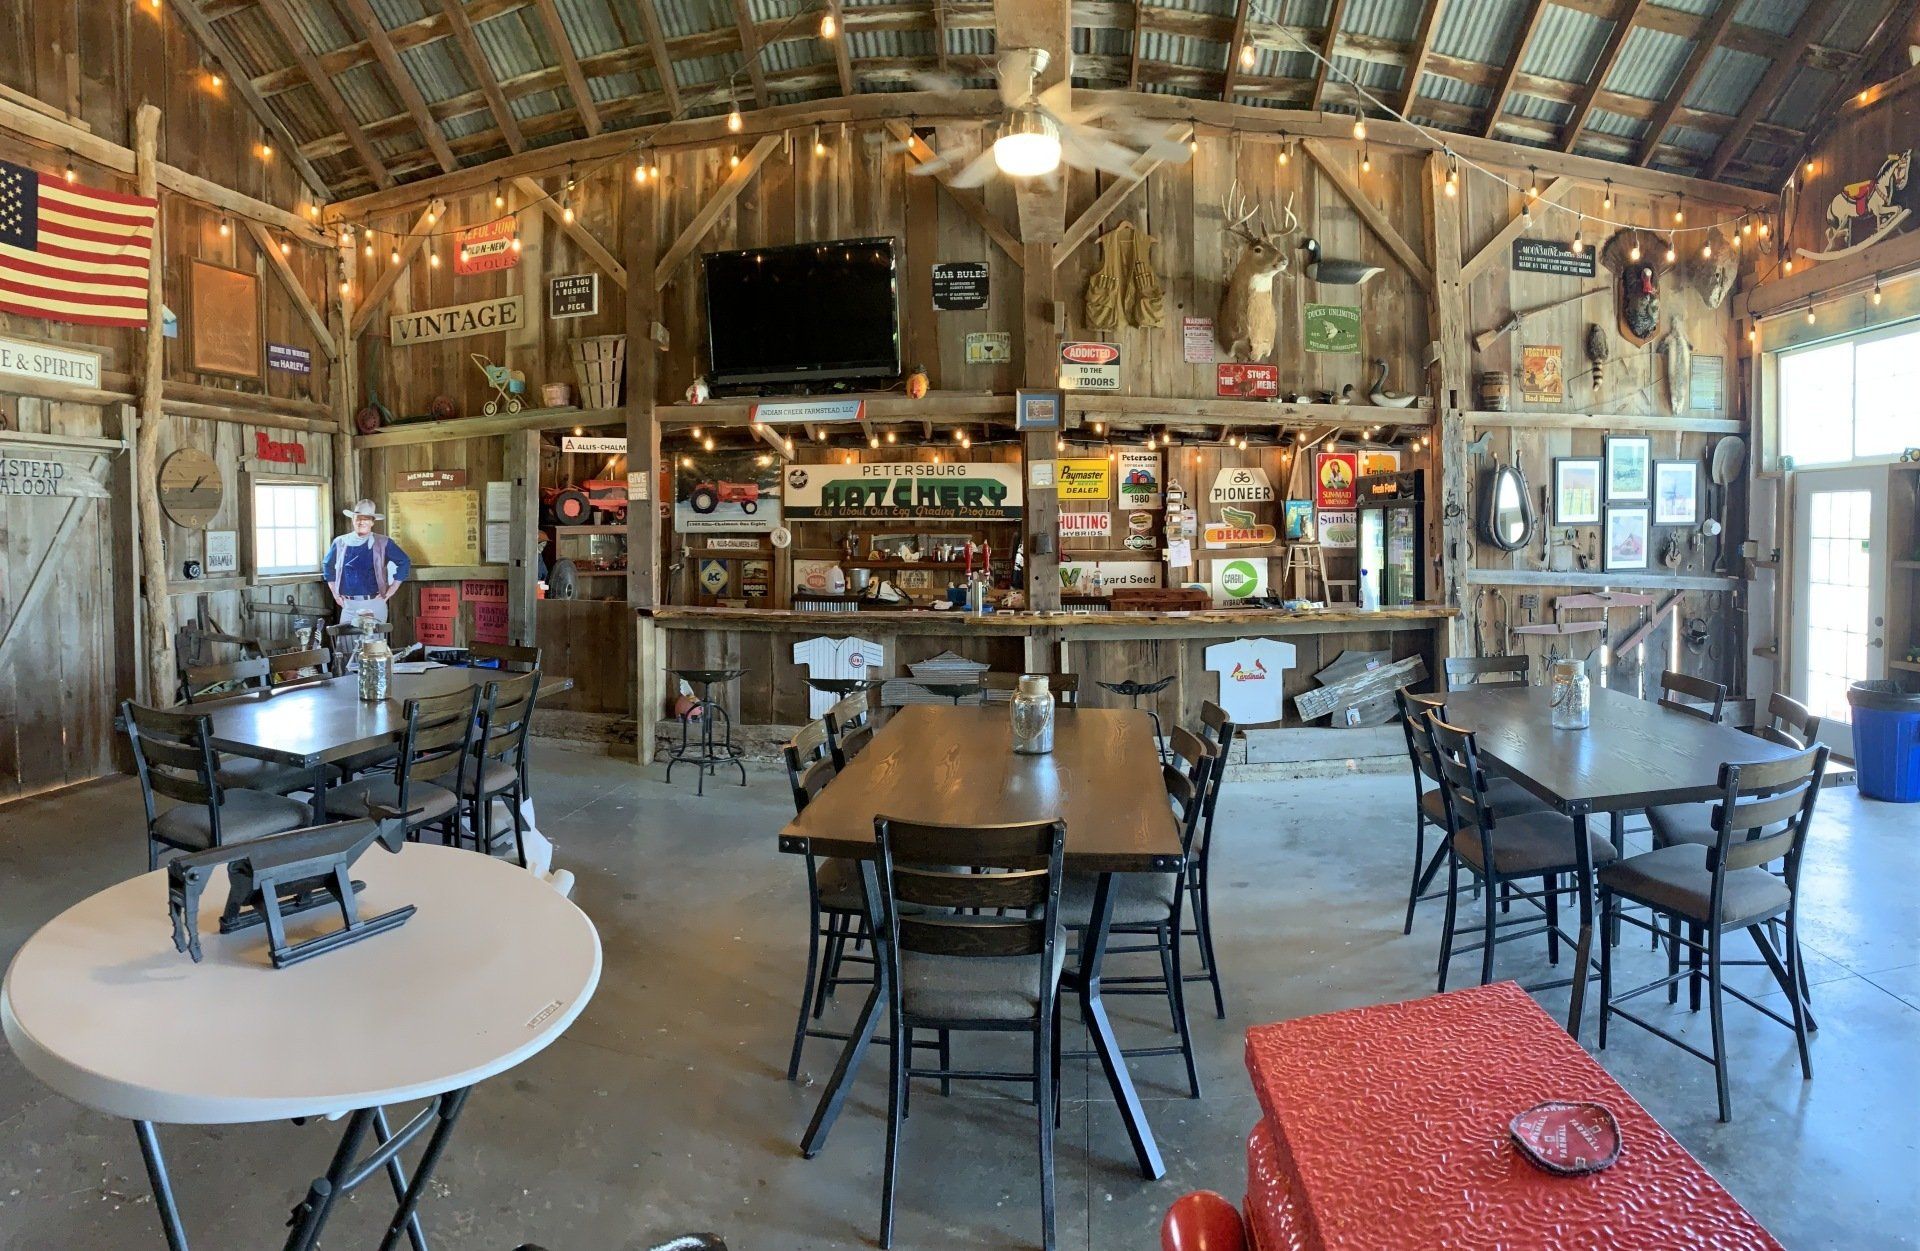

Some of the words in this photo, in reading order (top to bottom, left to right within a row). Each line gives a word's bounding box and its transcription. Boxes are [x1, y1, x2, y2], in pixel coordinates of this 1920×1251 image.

[934, 271, 954, 279] BAR
[956, 270, 987, 278] RULES
[555, 280, 573, 289] LOVE
[576, 278, 590, 286] YOU
[395, 301, 517, 340] VINTAGE
[1069, 347, 1111, 358] ADDICTED
[33, 354, 94, 382] SPIRITS
[280, 359, 304, 372] HARLEY
[1246, 370, 1271, 380] STOPS
[1220, 376, 1235, 386] THE
[1256, 380, 1277, 390] HERE
[1525, 394, 1538, 402] Bad
[1539, 395, 1561, 403] Hunter
[862, 465, 966, 476] PETERSBURG
[1060, 465, 1104, 485] Paymaster
[628, 472, 647, 483] GIVE
[0, 477, 58, 496] ALOON
[1372, 484, 1385, 495] Fresh
[1384, 481, 1397, 494] Food
[821, 481, 1008, 509] HATCHERY
[1130, 494, 1150, 503] 1980
[1213, 487, 1271, 501] PIONEER
[1325, 498, 1349, 506] VINEYARD
[814, 506, 833, 517] Ask
[839, 506, 867, 517] About
[870, 506, 888, 517] Our
[892, 505, 911, 517] Egg
[915, 506, 955, 518] Grading
[959, 506, 1005, 517] Program
[1059, 514, 1108, 530] HULTING
[1217, 529, 1264, 540] DEKALB
[1129, 574, 1156, 584] Seed
[1236, 671, 1266, 682] Cardinals
[1558, 1124, 1568, 1159] FARMALL
